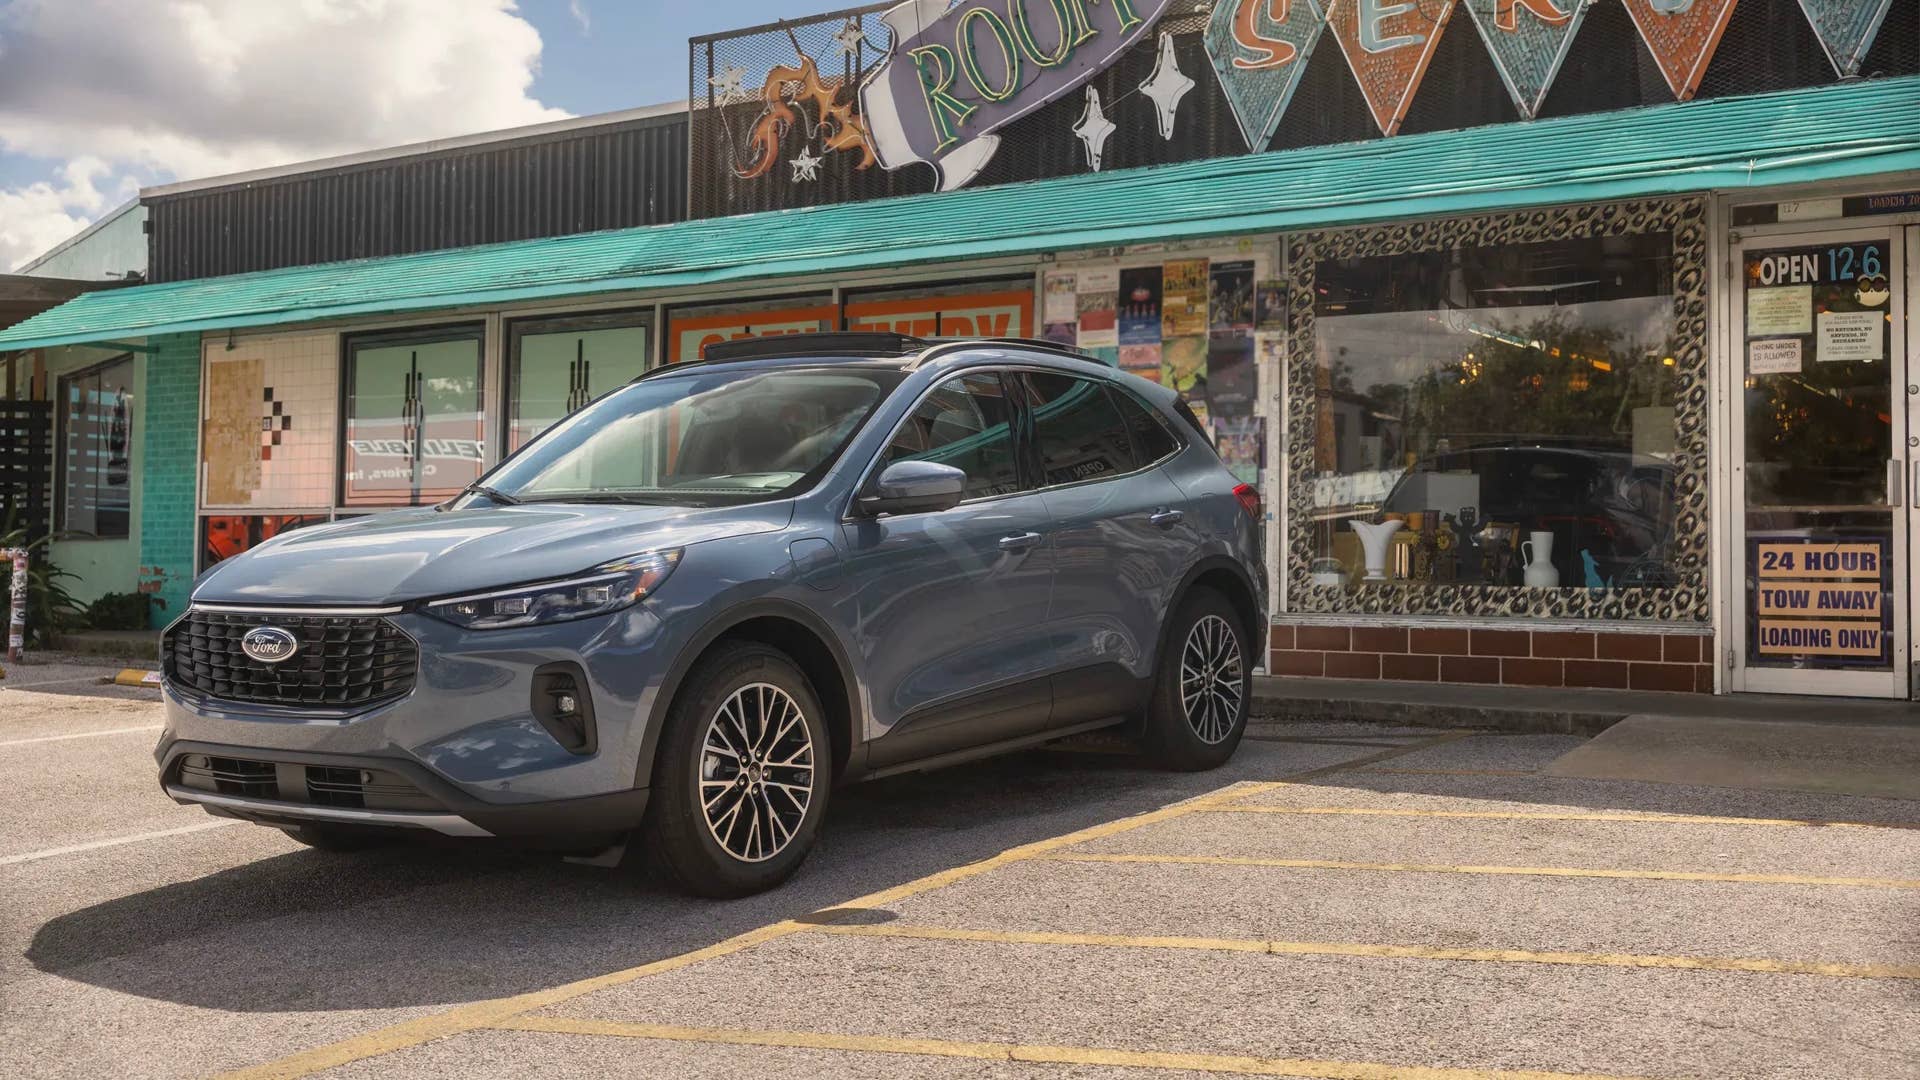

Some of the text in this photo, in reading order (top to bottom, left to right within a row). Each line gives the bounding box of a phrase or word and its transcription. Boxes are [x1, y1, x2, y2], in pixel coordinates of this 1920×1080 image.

[1760, 254, 1819, 285] OPEN
[1764, 351, 1797, 360] ALLOWED
[1762, 551, 1877, 571] 24 HOUR
[1761, 589, 1878, 610] TOW AWAY
[249, 634, 282, 654] Ford
[1761, 627, 1879, 649] LOADING ONLY
